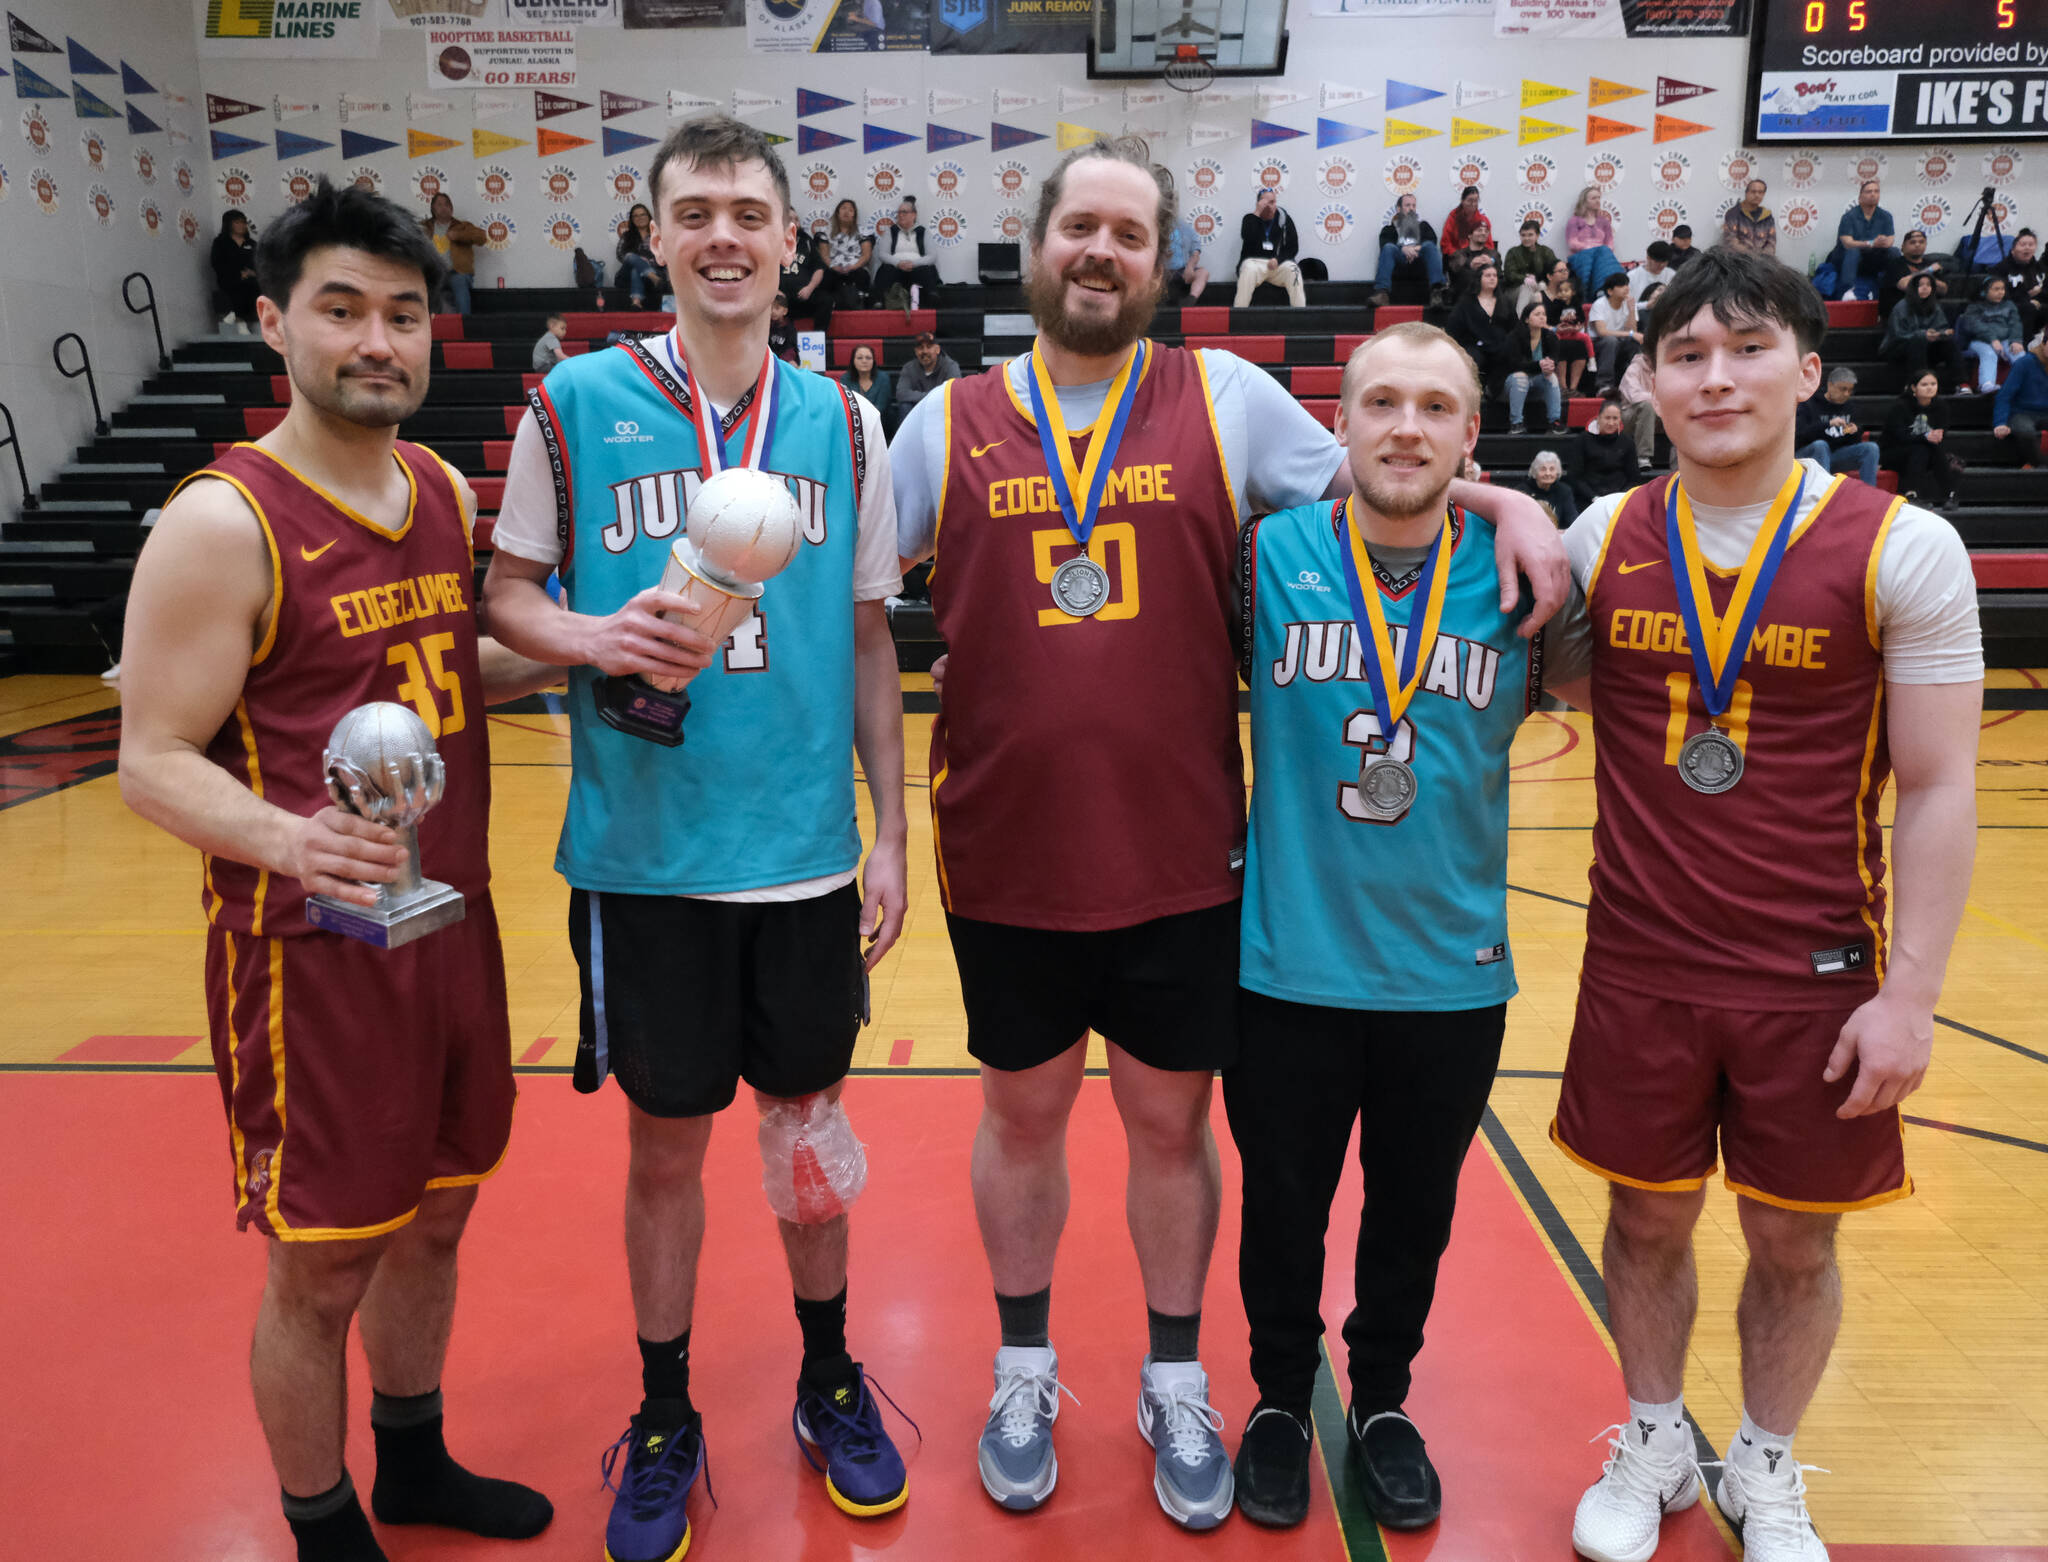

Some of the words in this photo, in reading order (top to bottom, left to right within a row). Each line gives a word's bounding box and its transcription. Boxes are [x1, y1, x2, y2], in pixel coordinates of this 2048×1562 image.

[276, 2, 361, 19] MARINE
[526, 10, 547, 18] SELF
[552, 10, 597, 18] STORAGE
[1007, 1, 1042, 13] JUNK
[1546, 10, 1565, 18] 100
[1569, 10, 1596, 18] Years
[773, 14, 814, 32] ALASKA
[1805, 2, 1824, 32] 0
[274, 22, 335, 39] LINES
[430, 32, 494, 43] HOOPTIME
[499, 31, 573, 42] BASKETBALL
[1802, 44, 1923, 66] Scoreboard
[1929, 42, 2019, 67] provided
[2026, 42, 2048, 66] by
[485, 72, 509, 84] GO
[514, 72, 576, 84] BEARS!
[1824, 92, 1846, 102] PLAY
[1858, 90, 1878, 100] COOL
[1916, 80, 2014, 125] IKE'S
[802, 337, 824, 356] Bay
[603, 435, 654, 444] WOOTER
[1032, 522, 1140, 627] 50
[1287, 582, 1331, 593] WOOTER
[330, 573, 468, 638] EDGECUMBE
[386, 632, 467, 740] 35
[1337, 708, 1418, 827] 3
[1849, 951, 1860, 962] M
